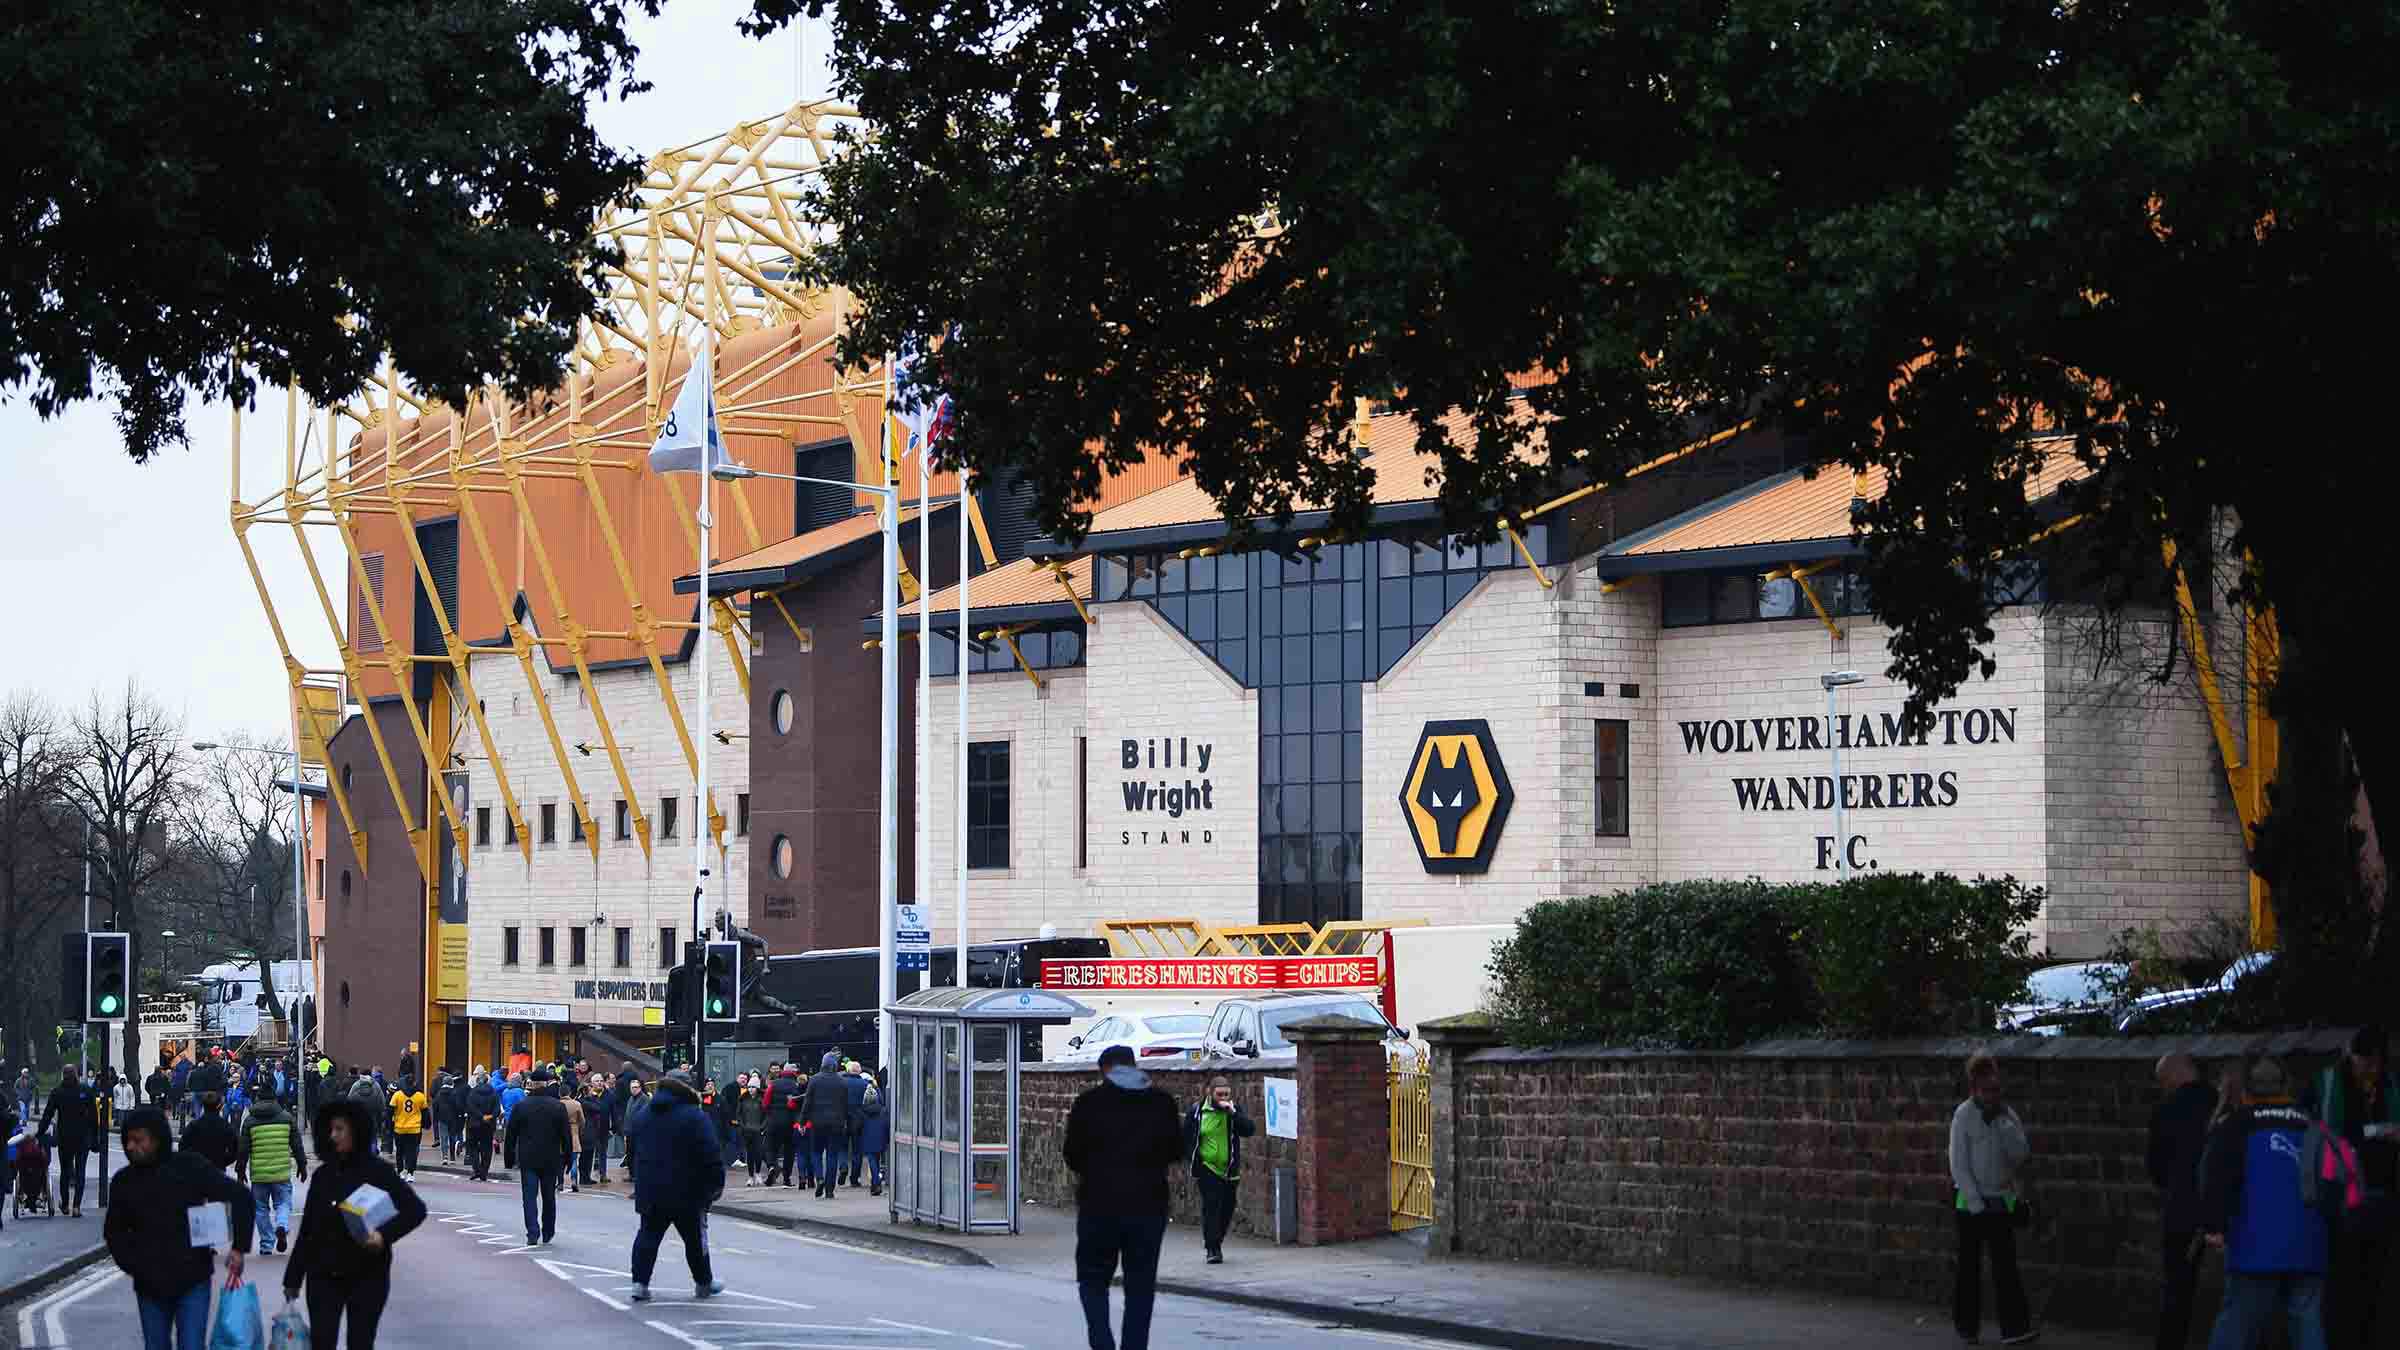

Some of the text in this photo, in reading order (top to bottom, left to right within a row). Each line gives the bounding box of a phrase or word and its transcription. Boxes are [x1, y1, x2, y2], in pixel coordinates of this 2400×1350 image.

[1678, 706, 2018, 754] WOLVERHAMPTON
[1121, 736, 1212, 773] Billy
[1122, 779, 1213, 818] Wright
[1731, 771, 1958, 811] WANDERERS
[1121, 829, 1213, 845] STAND
[1815, 835, 1878, 870] F.C.
[1063, 963, 1259, 986] REFRESHMENTS
[1299, 962, 1361, 985] CHIPS
[598, 981, 647, 1001] SUPPORTERS
[140, 1003, 182, 1014] BURGERS
[143, 1013, 188, 1023] HOTDOGS
[404, 1099, 413, 1113] 8
